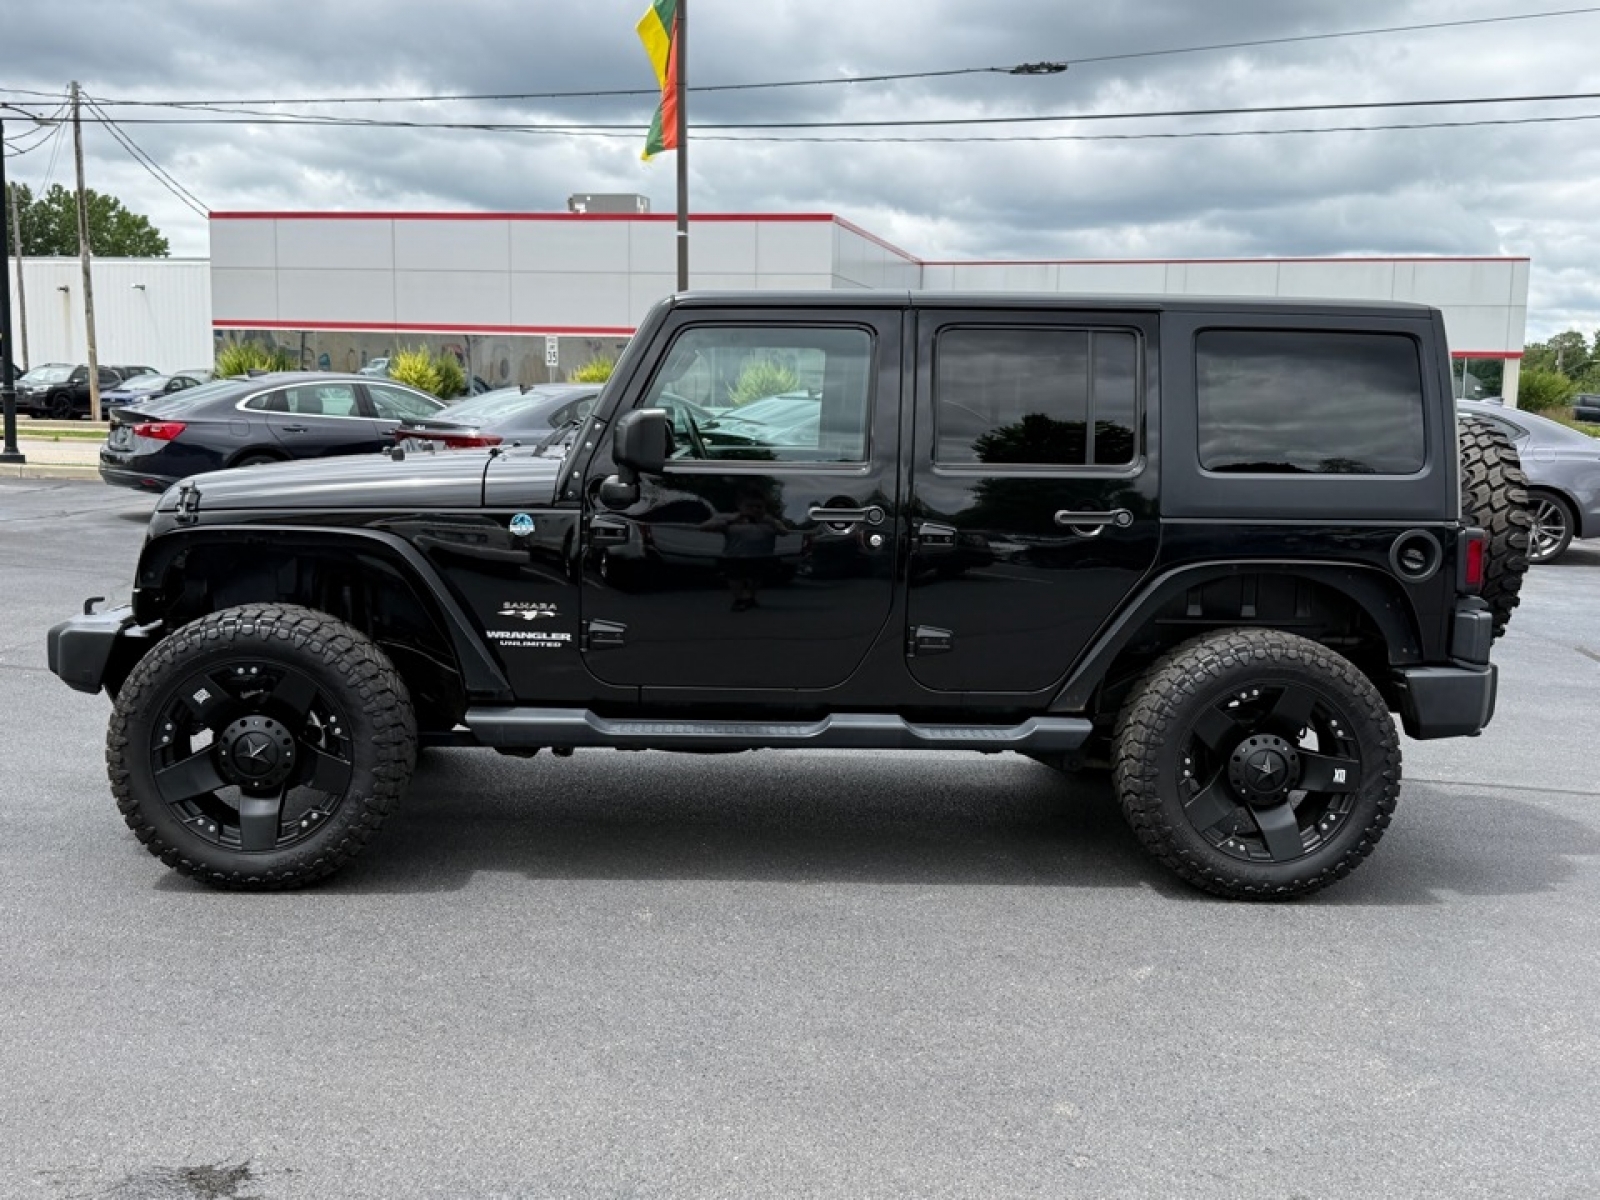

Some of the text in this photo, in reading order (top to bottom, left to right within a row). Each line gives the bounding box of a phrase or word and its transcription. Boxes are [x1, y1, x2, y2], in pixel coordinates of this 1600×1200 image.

[503, 602, 557, 610] SAHARA
[486, 630, 572, 641] WRANGLER
[500, 640, 562, 648] UNLIMITED
